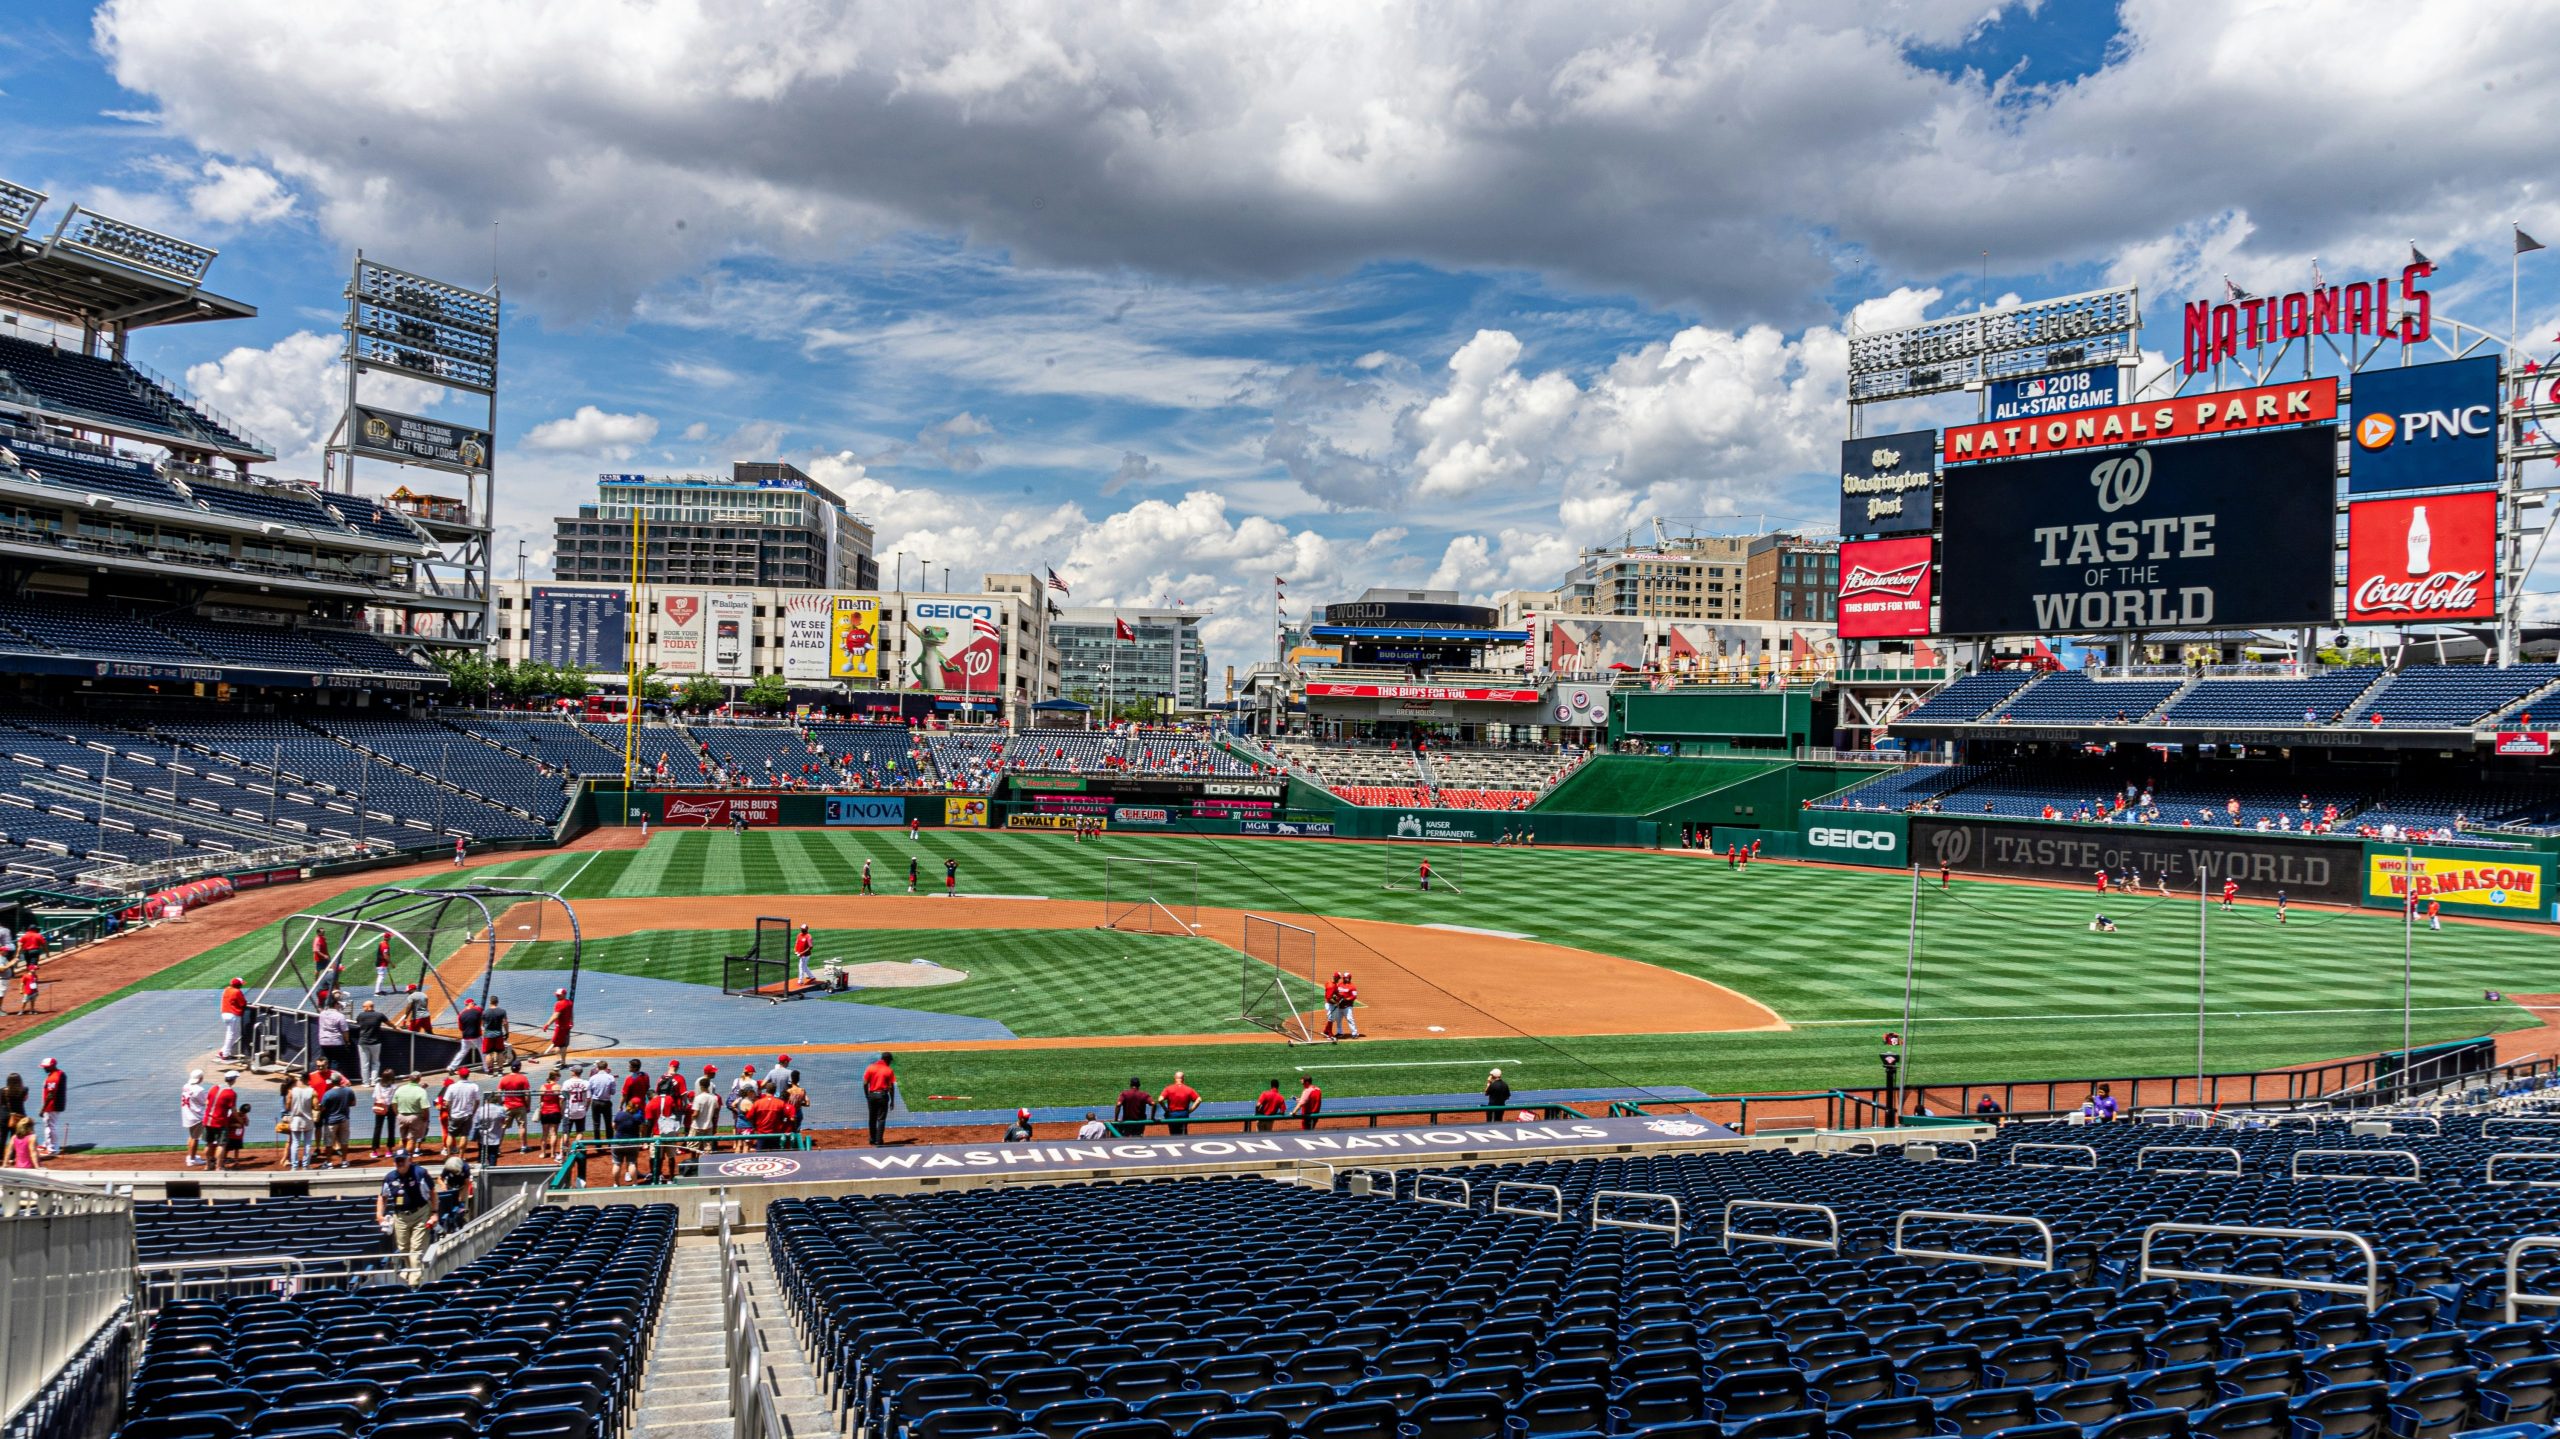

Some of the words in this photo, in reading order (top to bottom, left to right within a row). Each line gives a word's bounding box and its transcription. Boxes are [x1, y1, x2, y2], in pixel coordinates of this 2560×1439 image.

[2184, 262, 2432, 375] NATIONALS
[2048, 373, 2090, 394] 2018
[1996, 403, 2020, 420] ALL
[2031, 396, 2066, 414] STAR
[2069, 389, 2114, 409] GAME
[401, 420, 422, 431] DEVILS
[422, 424, 452, 437] BACKBONE
[1955, 407, 2173, 454] NATIONALS
[2197, 390, 2311, 424] PARK
[2400, 405, 2490, 441] PNC
[400, 428, 425, 440] BREWING
[426, 433, 453, 445] COMPANY
[11, 439, 27, 449] TEXT
[48, 447, 67, 457] ISSUE
[74, 453, 105, 464] LOCATION
[106, 458, 115, 466] TO
[393, 439, 412, 451] LEFT
[412, 442, 434, 456] FIELD
[435, 446, 459, 460] LODGE
[1872, 448, 1900, 468] The
[1843, 470, 1930, 493] Washington
[1867, 496, 1903, 520] Post
[2034, 514, 2216, 567] TASTE
[1846, 572, 1920, 588] Budweiser
[2085, 568, 2111, 587] OF
[2117, 565, 2159, 584] THE
[2354, 570, 2485, 612] Coca-Cola
[719, 601, 748, 609] Ballpark
[916, 604, 992, 620] GEICO
[1336, 603, 1386, 619] WORLD
[1845, 603, 1862, 613] THIS
[1863, 602, 1886, 612] BUD'S
[1887, 601, 1903, 611] FOR
[1904, 601, 1923, 610] YOU.
[2033, 586, 2214, 629] WORLD
[791, 620, 806, 629] WE
[808, 621, 826, 629] SEE
[663, 640, 698, 649] TODAY
[790, 640, 825, 649] AHEAD
[1527, 627, 1535, 646] TEAM
[1396, 652, 1419, 660] LIGHT
[1422, 653, 1442, 661] LOFT
[1526, 647, 1534, 670] STORE
[114, 663, 151, 677] TASTE
[154, 668, 163, 676] OF
[165, 669, 177, 677] THE
[180, 667, 222, 681] WORLD
[328, 676, 361, 687] TASTE
[386, 680, 421, 690] WORLD
[1377, 686, 1398, 697] THIS
[1400, 687, 1426, 697] BUD'S
[1427, 688, 1446, 698] FOR
[1447, 689, 1468, 698] YOU.
[1969, 728, 2007, 739] TASTE
[2019, 730, 2032, 738] THE
[2035, 729, 2079, 740] WORLD
[2224, 732, 2270, 744] TASTE
[2272, 734, 2284, 742] OF
[2286, 735, 2302, 743] THE
[2306, 733, 2362, 745] WORLD
[1244, 785, 1280, 796] FAN
[671, 802, 718, 814] Budweiser
[729, 800, 751, 810] THIS
[751, 800, 777, 810] BUD'S
[846, 803, 903, 818] INOVA
[749, 811, 768, 820] YOU.
[1245, 822, 1269, 830] MGM
[1306, 824, 1330, 832] MGM
[1426, 821, 1450, 829] KAISER
[1808, 827, 1896, 851] GEICO
[1994, 836, 2100, 869] TASTE
[2104, 849, 2132, 870] OF
[2143, 851, 2183, 874] THE
[2188, 848, 2330, 886] WORLD
[2378, 861, 2402, 871] WHO
[571, 1090, 583, 1103] 31
[859, 1139, 1283, 1169] WASHINGTON
[1294, 1125, 1609, 1150] NATIONALS
